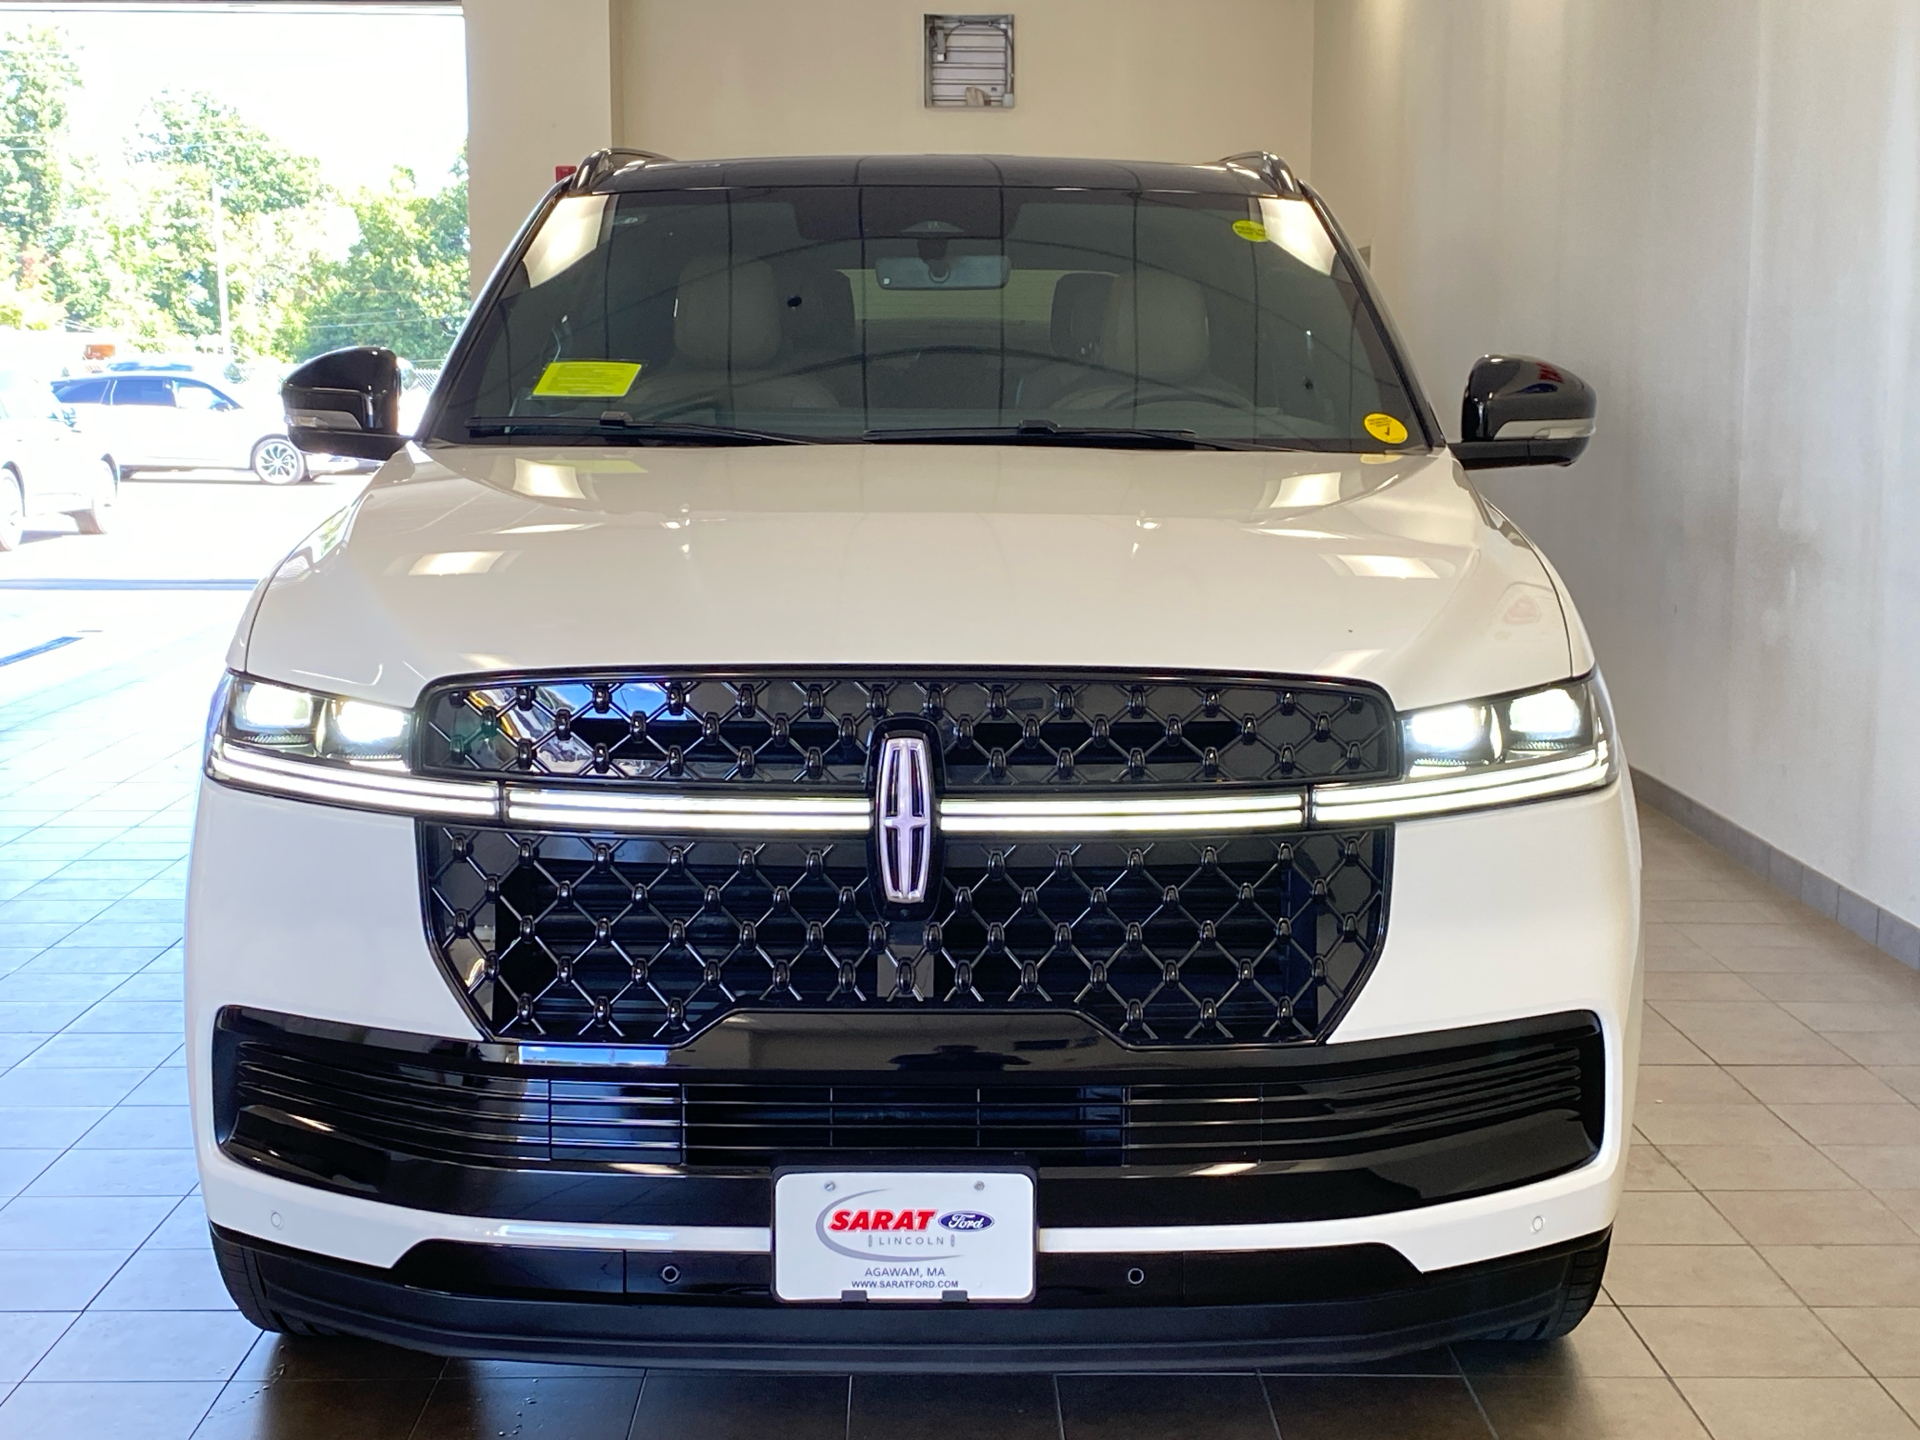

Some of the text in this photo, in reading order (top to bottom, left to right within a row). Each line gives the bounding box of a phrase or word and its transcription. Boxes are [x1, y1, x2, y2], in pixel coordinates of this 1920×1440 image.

[829, 1209, 985, 1232] SARAT Ford
[878, 1236, 944, 1246] LINCOLN
[864, 1267, 946, 1278] AGAWAM, MA
[851, 1280, 959, 1289] WWW.SARATFORD.COM
